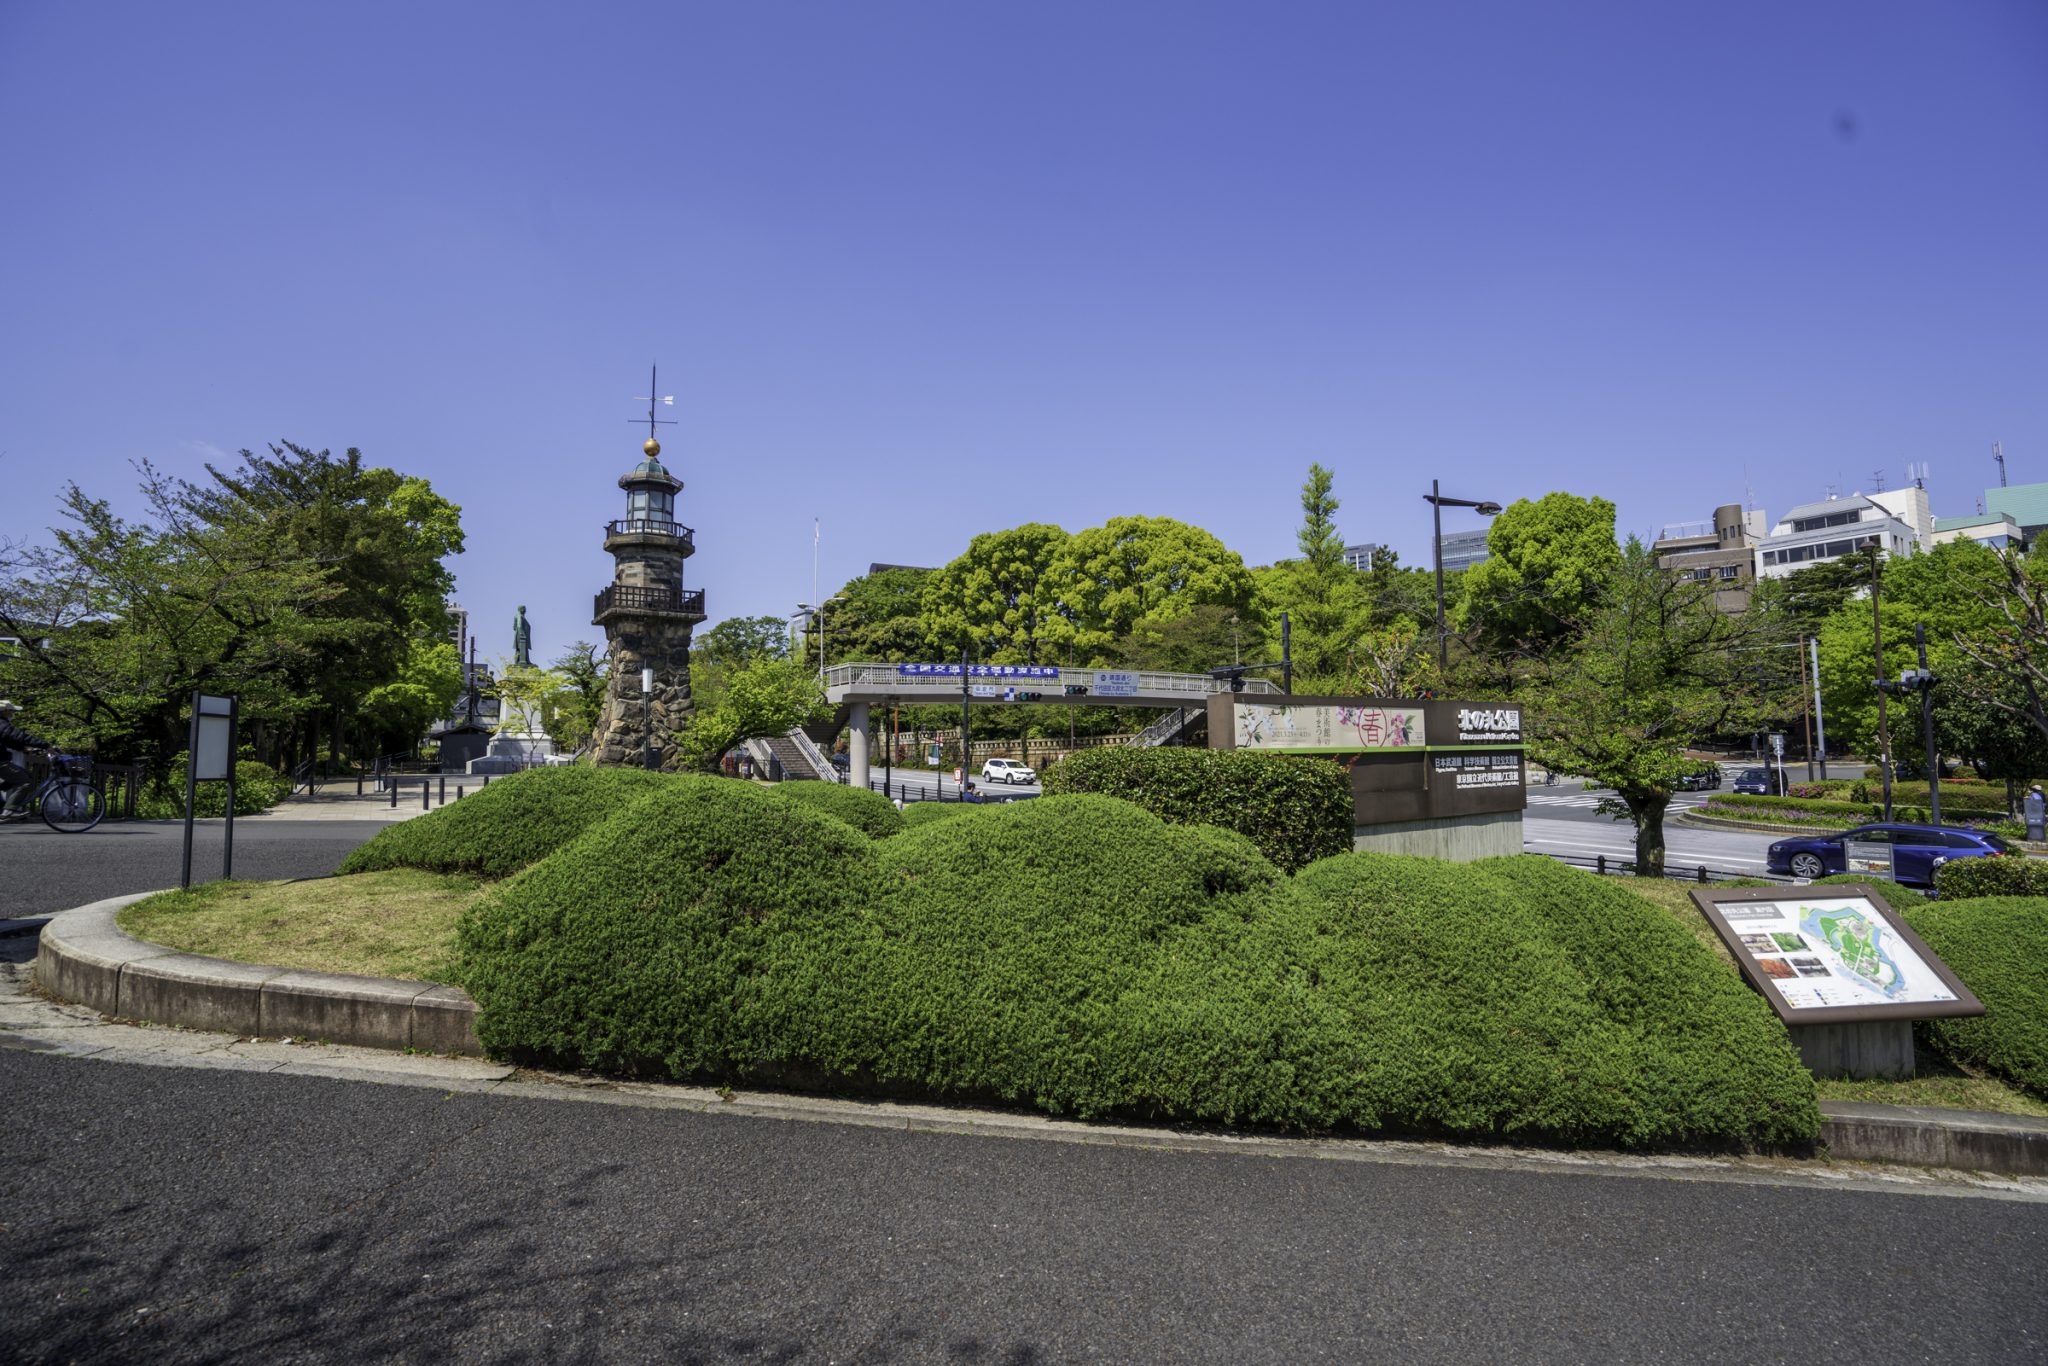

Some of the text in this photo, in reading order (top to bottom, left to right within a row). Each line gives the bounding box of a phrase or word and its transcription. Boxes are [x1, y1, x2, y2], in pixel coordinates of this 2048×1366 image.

[1458, 709, 1520, 730] 北の丸公園
